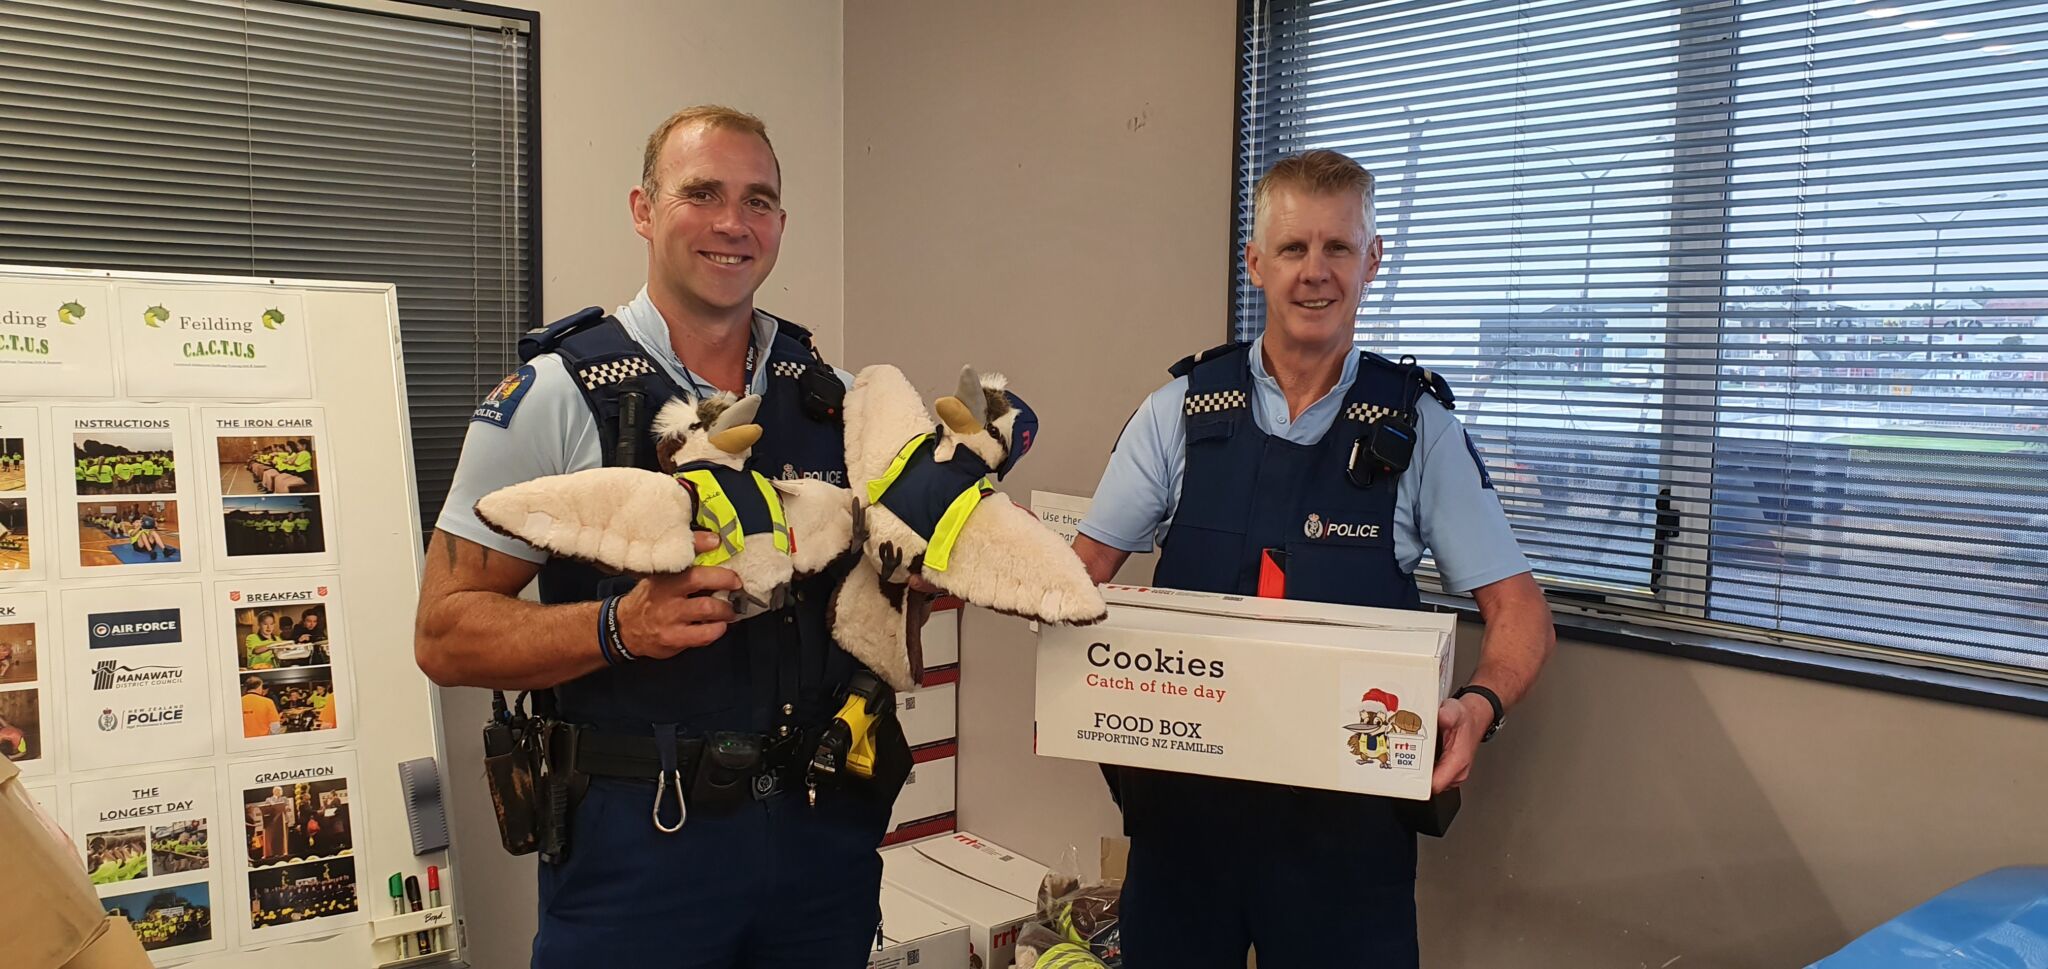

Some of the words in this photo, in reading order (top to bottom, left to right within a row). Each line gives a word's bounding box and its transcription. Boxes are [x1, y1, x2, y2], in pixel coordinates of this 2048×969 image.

[0, 311, 47, 328] ding
[179, 316, 253, 333] Feilding
[75, 419, 170, 428] INSTRUCTIONS
[216, 419, 240, 428] THE
[244, 419, 273, 428] IRON
[277, 418, 313, 428] CHAIR
[1042, 511, 1060, 522] Use
[1327, 523, 1379, 537] POLICE
[246, 590, 313, 603] BREAKFAST
[111, 624, 133, 634] AIR
[135, 620, 177, 632] FORCE
[1087, 642, 1225, 678] Cookies
[116, 669, 183, 683] MANAWATU
[1086, 673, 1134, 691] Catch
[1140, 680, 1157, 693] of
[1161, 681, 1188, 696] the
[1193, 684, 1226, 703] day
[127, 709, 183, 725] POLICE
[1094, 712, 1154, 733] FOOD
[1159, 719, 1202, 739] BOX
[1077, 730, 1149, 747] SUPPORTING
[1151, 738, 1168, 749] NZ
[1170, 740, 1224, 755] FAMILIES
[1394, 752, 1416, 760] FOOD
[255, 766, 334, 784] GRADUATION
[132, 787, 160, 799] THE
[100, 804, 162, 822] LONGEST
[167, 800, 194, 812] DAY
